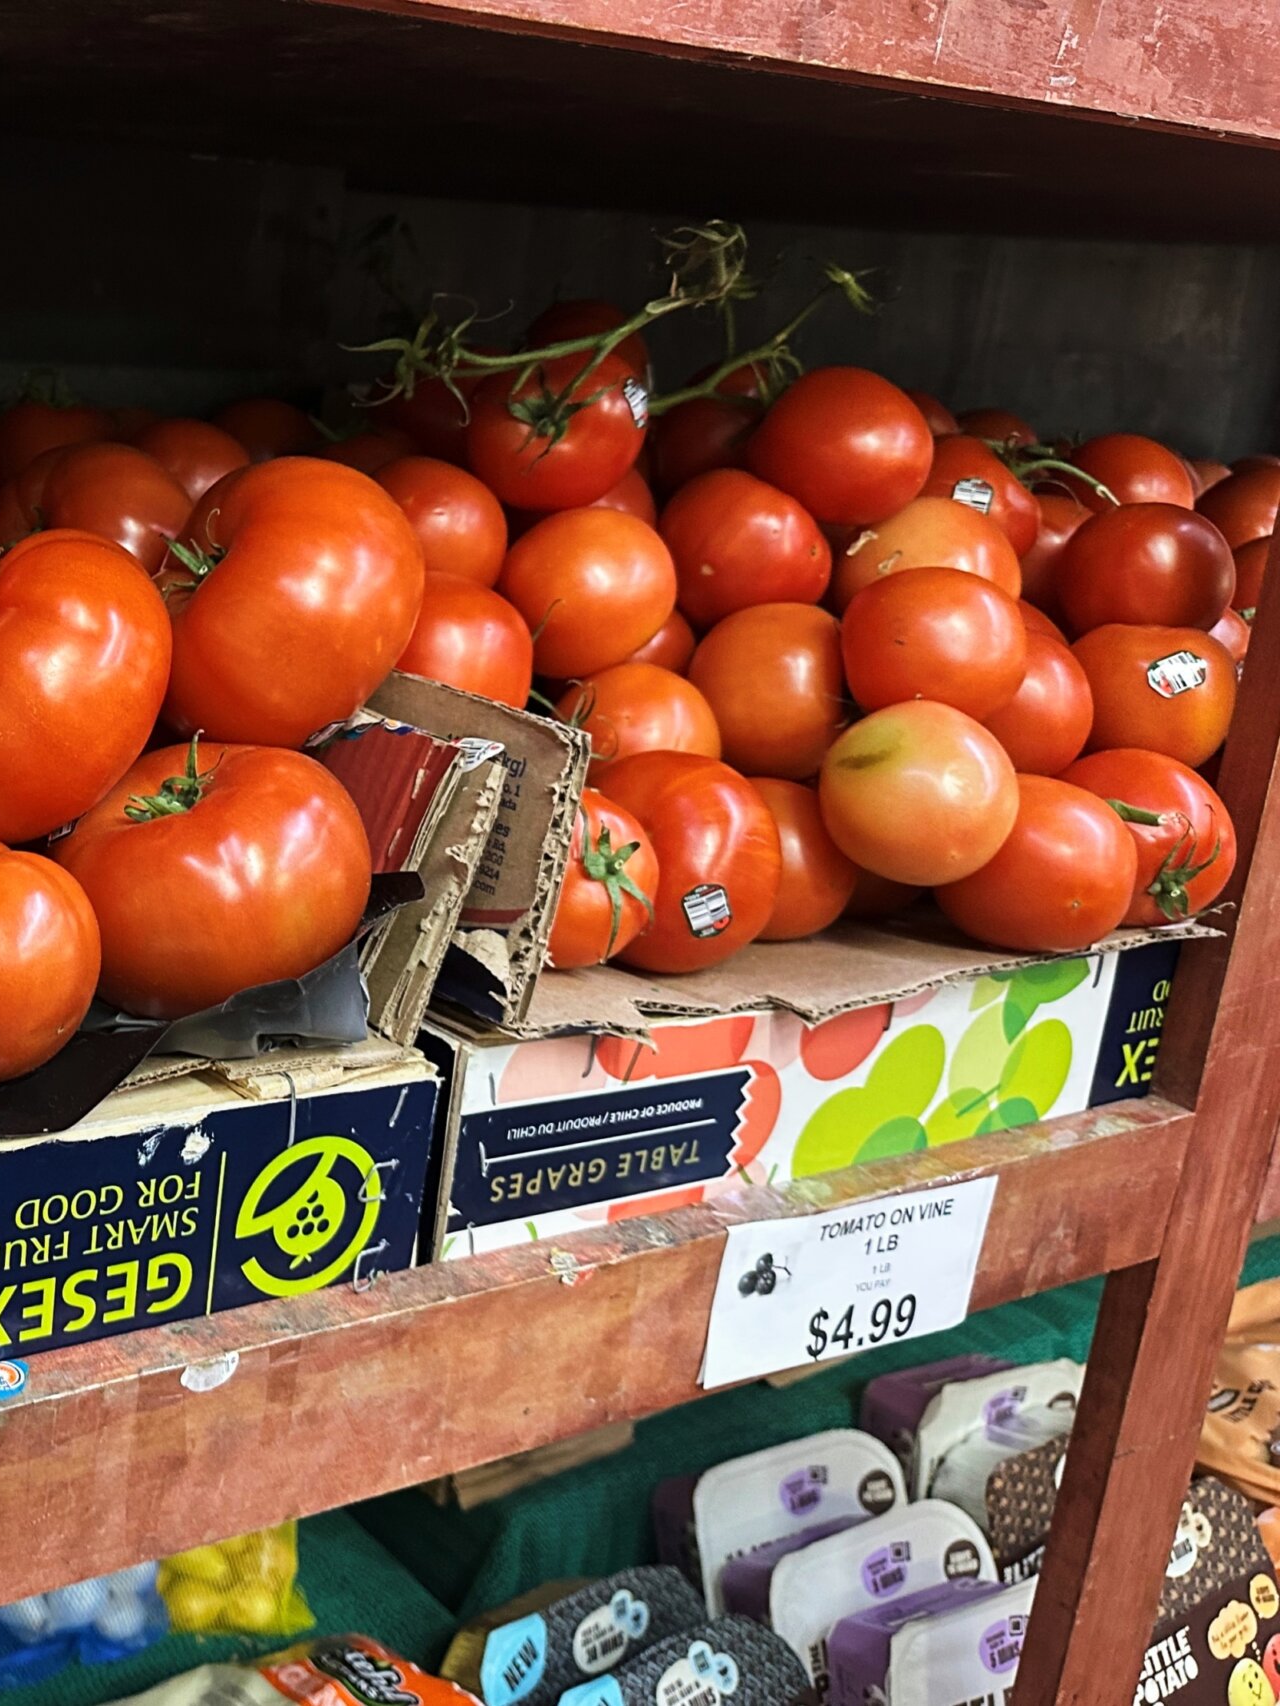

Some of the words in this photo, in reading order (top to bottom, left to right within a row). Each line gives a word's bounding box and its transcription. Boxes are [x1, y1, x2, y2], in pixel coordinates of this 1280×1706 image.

[1125, 1007, 1164, 1034] RUIT
[609, 1108, 639, 1124] CHILE
[640, 1106, 655, 1119] OF
[656, 1097, 703, 1115] PRODUCE
[507, 1126, 535, 1141] CHILI
[537, 1122, 554, 1136] DU
[555, 1114, 602, 1133] PRODUIT
[616, 1139, 702, 1178] TABLE
[136, 1171, 201, 1208] FOR
[490, 1157, 607, 1202] GRAPES
[15, 1184, 123, 1230] GOOD
[820, 1212, 886, 1242] TOMATO
[890, 1205, 915, 1226] ON
[919, 1198, 955, 1220] VINE
[82, 1206, 200, 1255] SMART
[864, 1238, 872, 1256] 1
[876, 1234, 899, 1253] LB
[855, 1281, 872, 1293] YOU
[874, 1278, 891, 1290] PAY
[806, 1293, 917, 1362] $4.99
[502, 1637, 539, 1692] NEW
